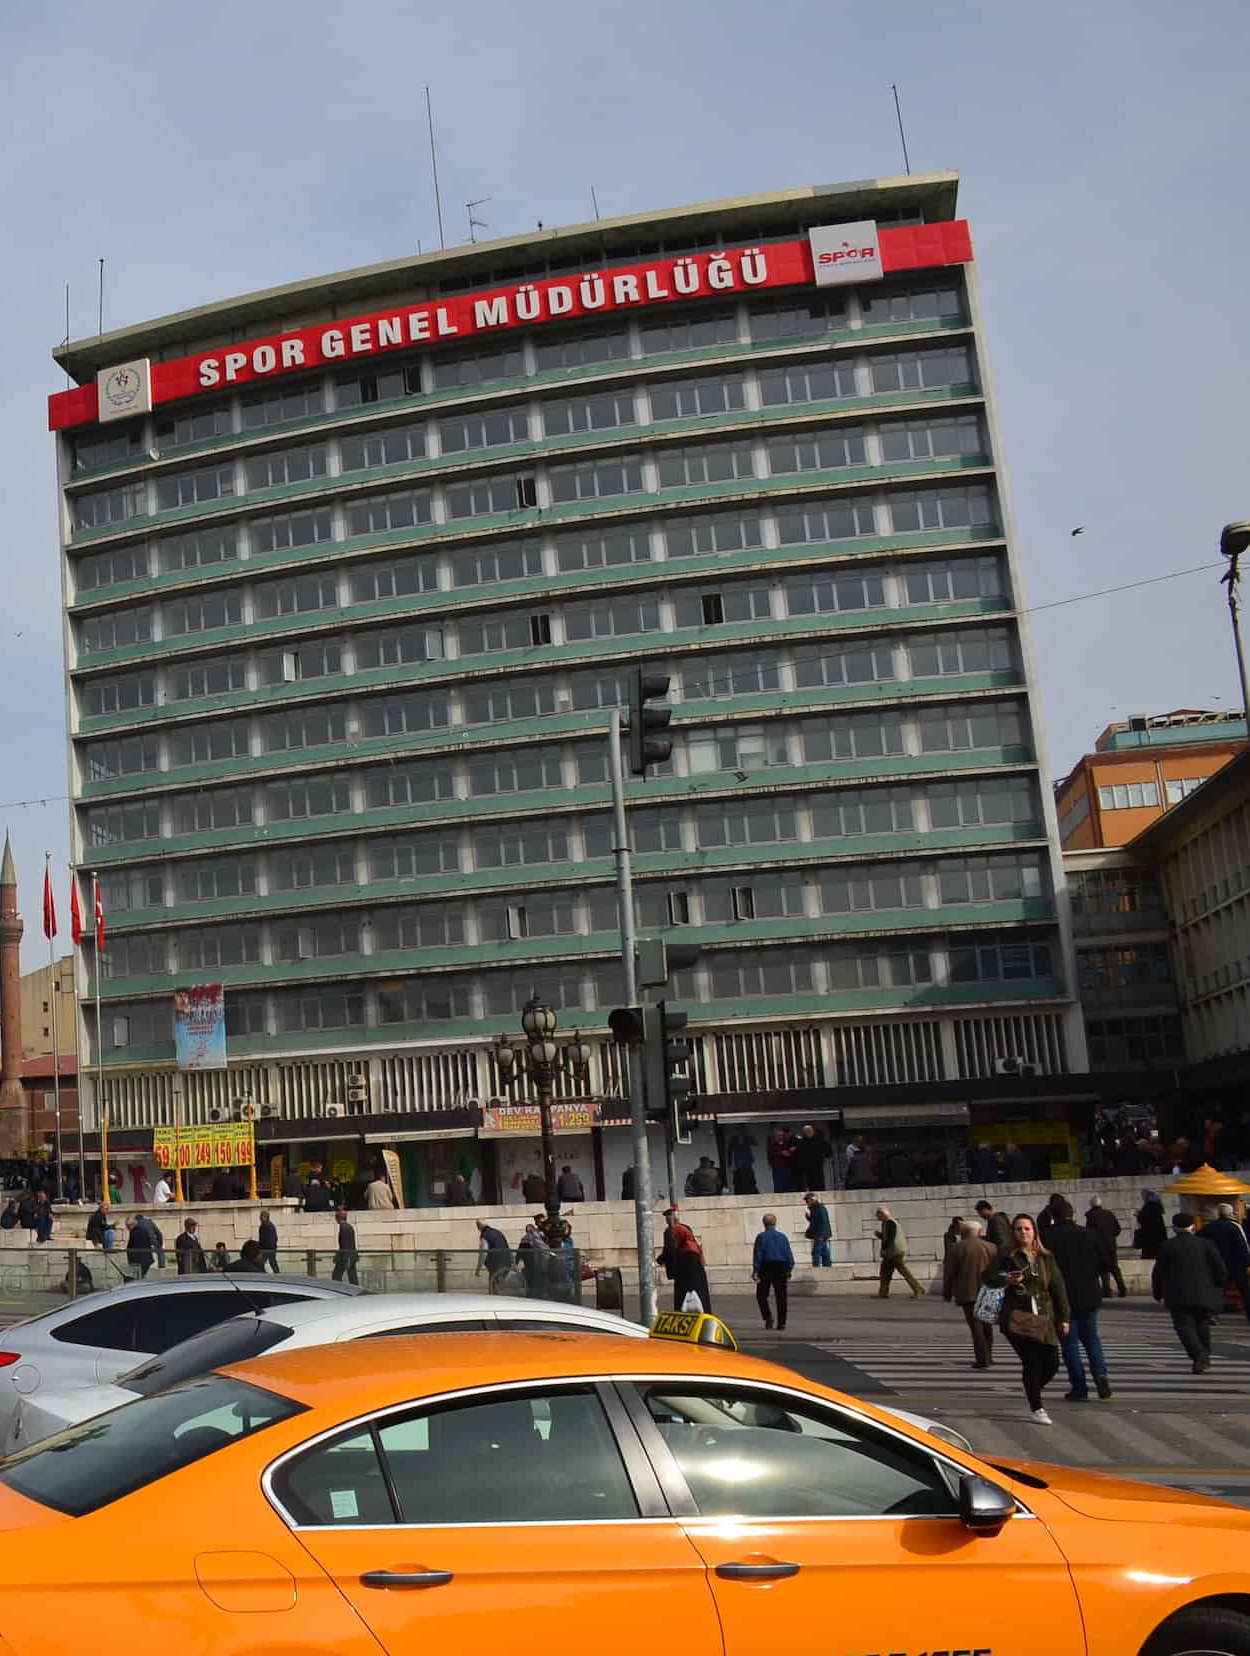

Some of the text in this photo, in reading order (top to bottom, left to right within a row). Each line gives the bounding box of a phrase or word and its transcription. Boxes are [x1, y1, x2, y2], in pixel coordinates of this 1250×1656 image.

[818, 247, 875, 264] SPOR
[199, 248, 768, 388] SPOR GENEL MÜDÜRLÜĞÜ
[500, 1103, 588, 1116] DEV KAPANYA
[195, 1142, 211, 1165] 249
[214, 1141, 232, 1164] 150
[657, 1315, 695, 1335] TAKSİ
